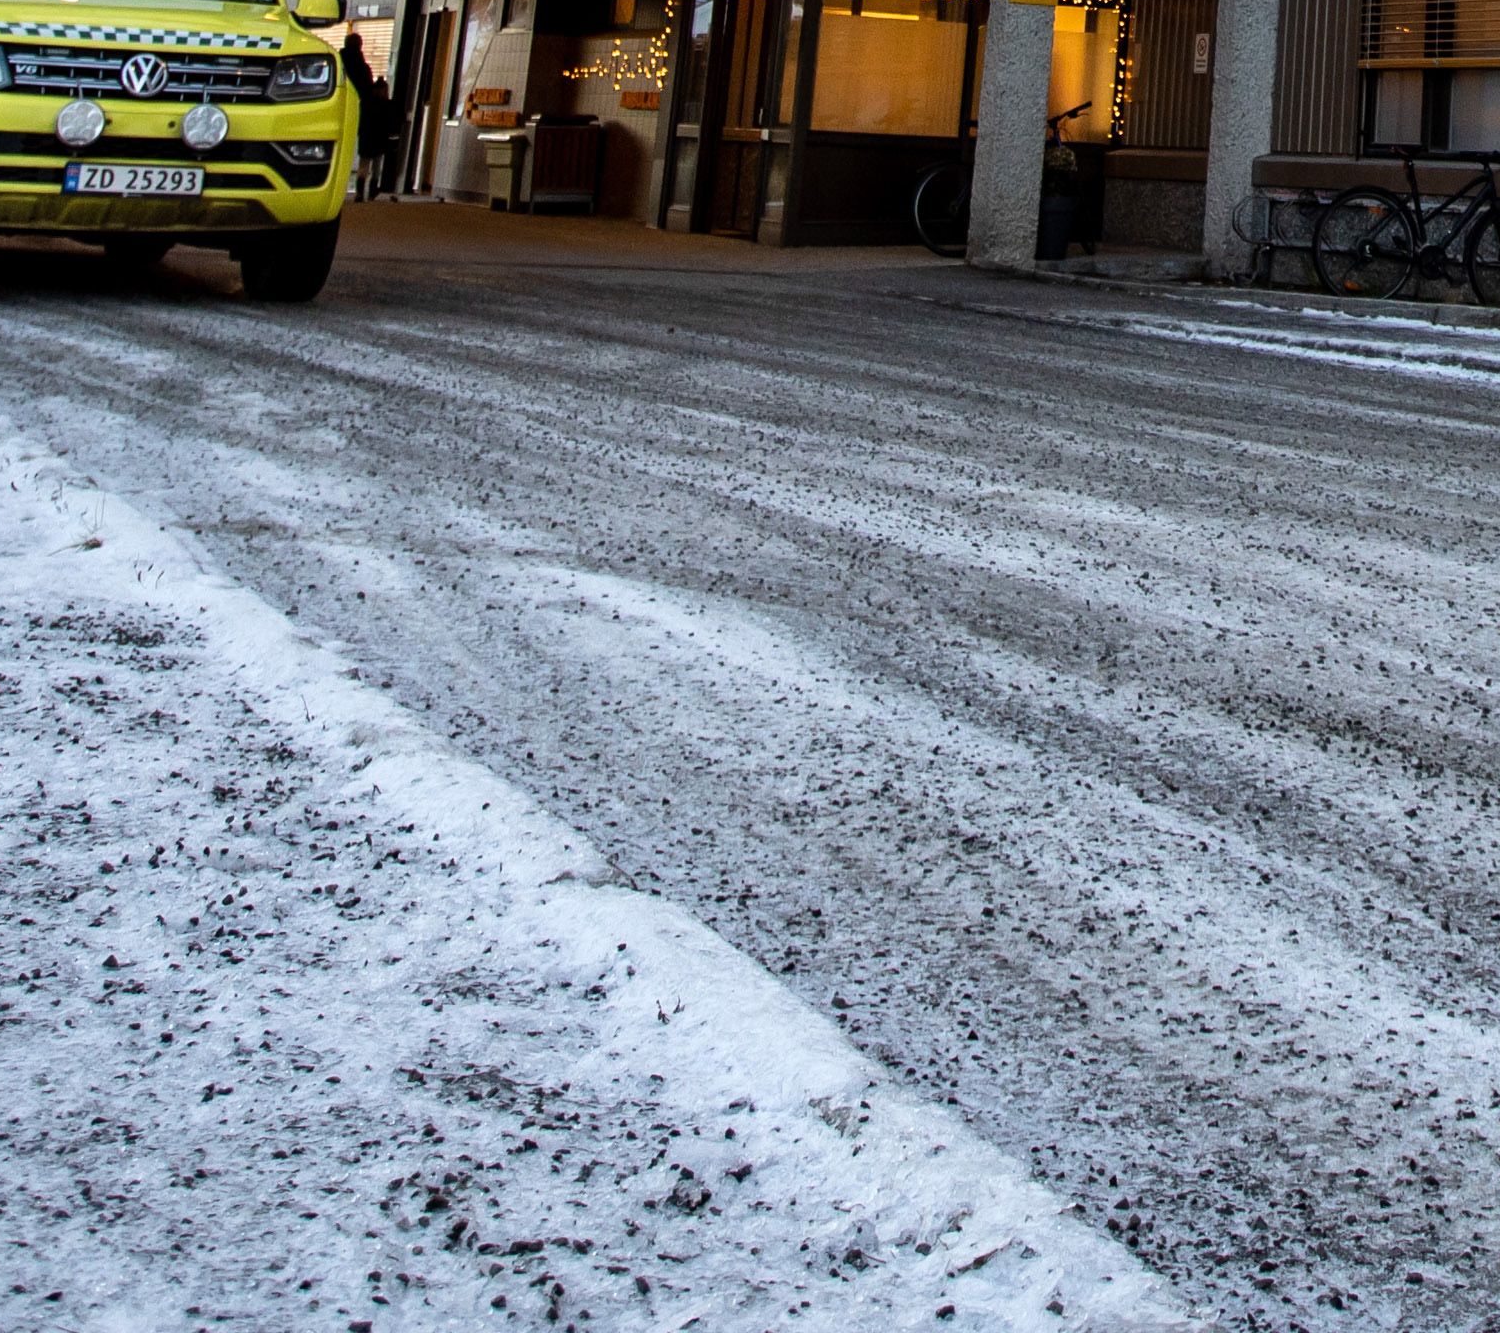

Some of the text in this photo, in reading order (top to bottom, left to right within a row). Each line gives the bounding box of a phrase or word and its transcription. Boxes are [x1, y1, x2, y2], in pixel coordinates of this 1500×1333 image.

[14, 64, 38, 75] V6
[84, 168, 198, 192] ZD 25293
